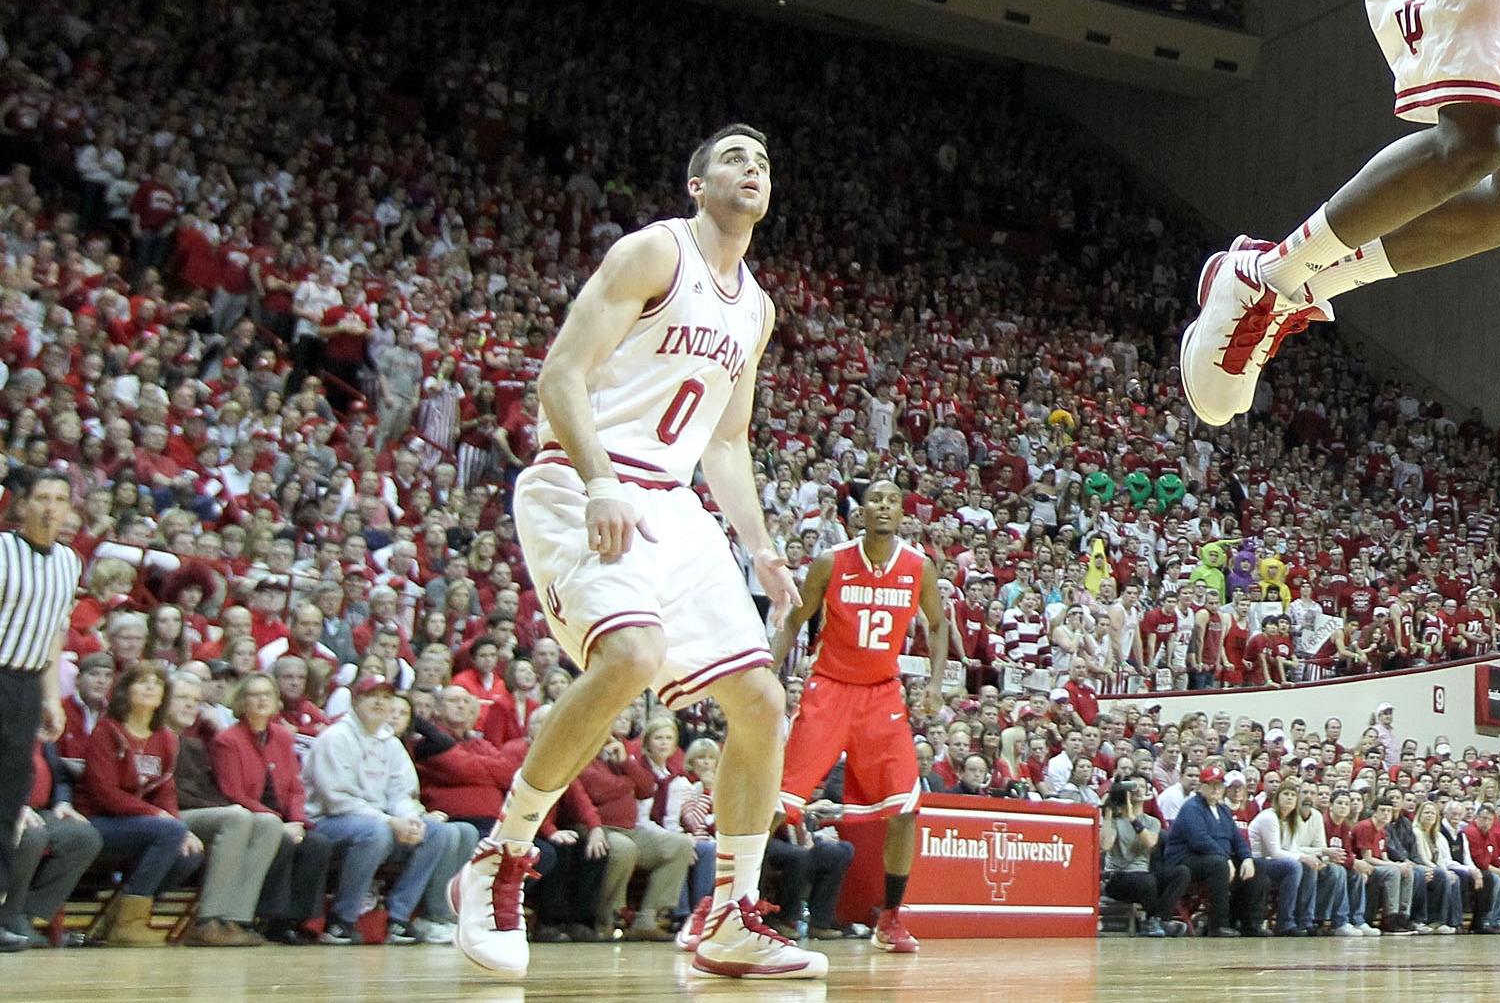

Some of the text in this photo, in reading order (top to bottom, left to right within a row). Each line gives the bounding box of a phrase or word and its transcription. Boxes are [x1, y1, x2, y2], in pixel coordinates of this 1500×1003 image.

[656, 325, 746, 382] INDIANA
[657, 377, 706, 446] 0
[841, 584, 912, 608] OHIO STATE
[857, 608, 894, 651] 12
[1434, 688, 1444, 711] 9
[920, 827, 1074, 868] Indiana University
